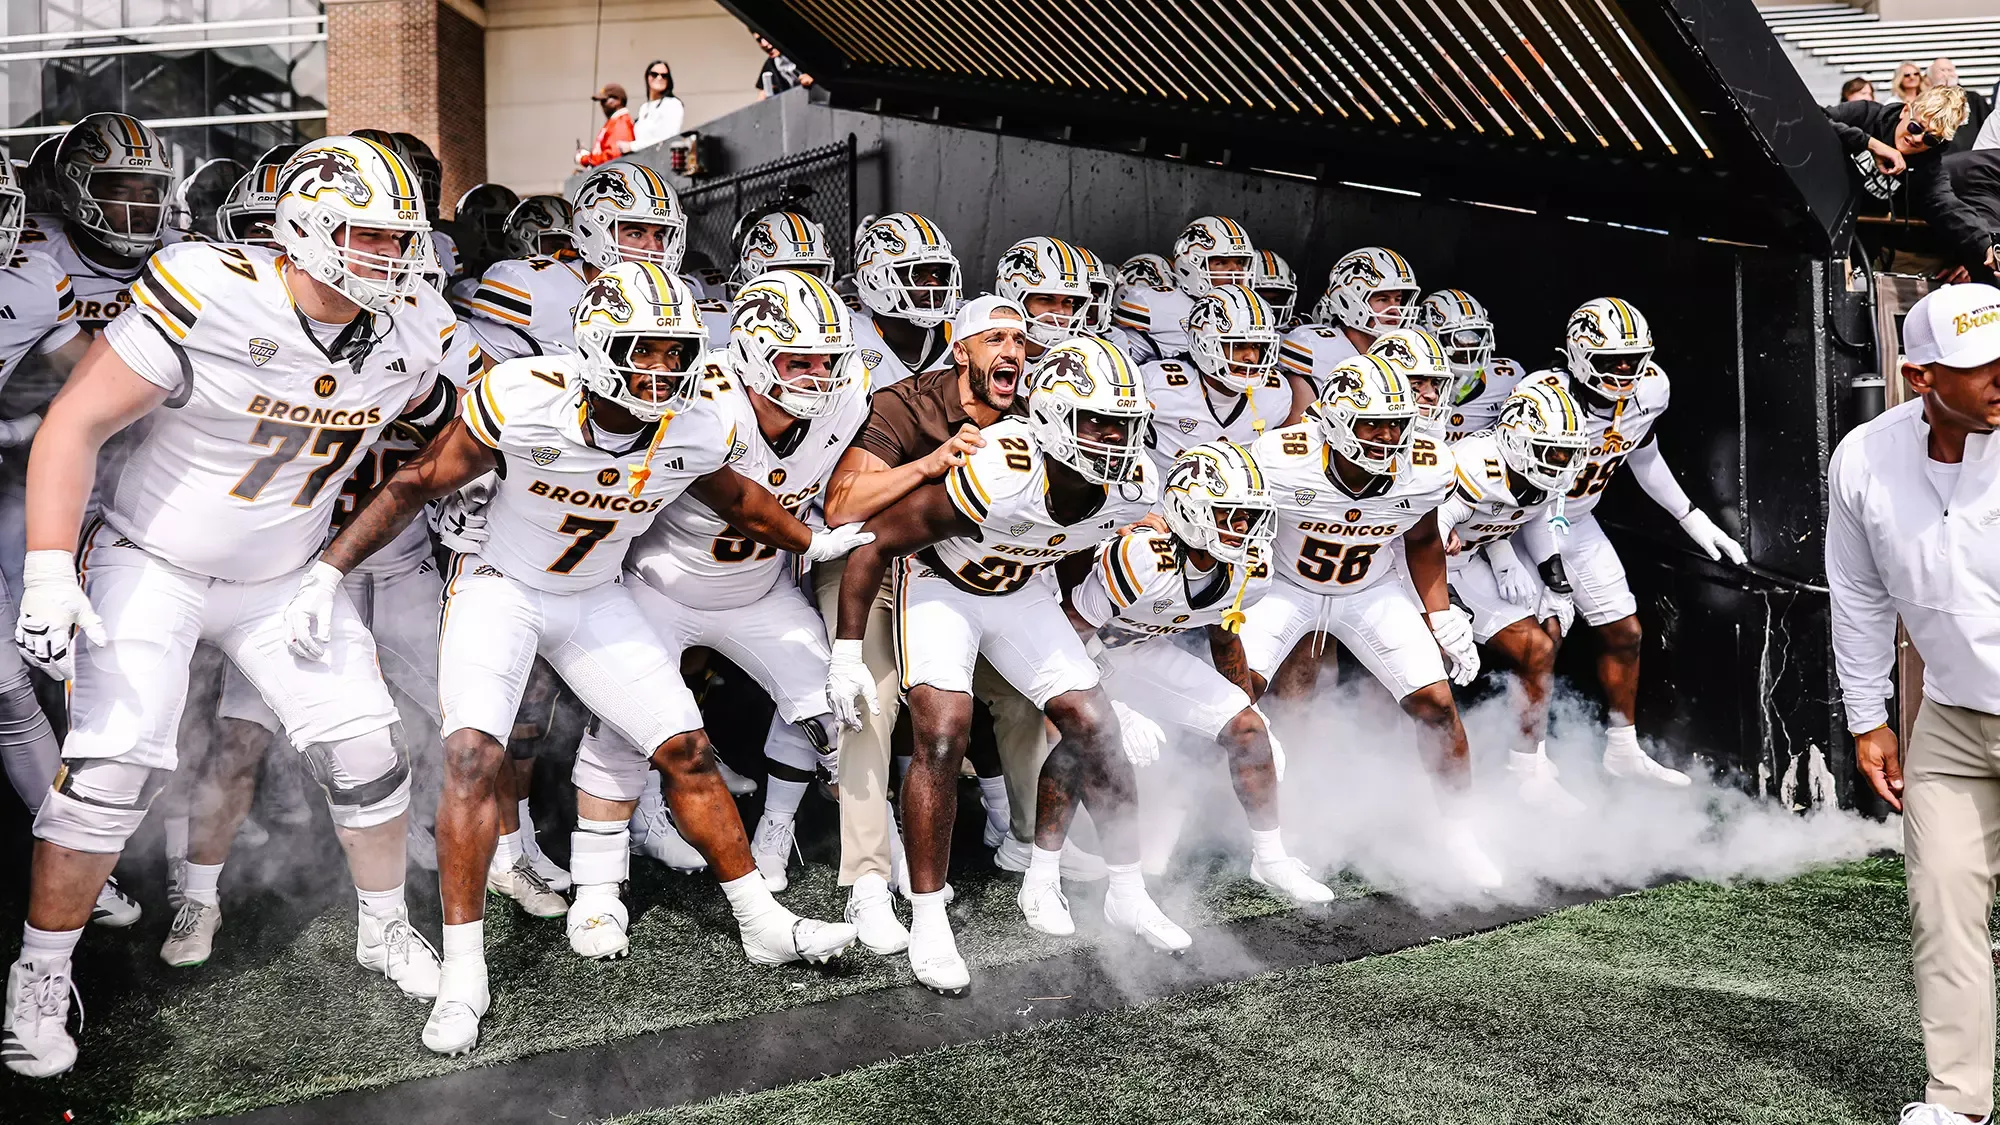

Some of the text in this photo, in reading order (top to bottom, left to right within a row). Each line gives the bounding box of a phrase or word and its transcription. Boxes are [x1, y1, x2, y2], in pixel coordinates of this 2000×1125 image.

[129, 158, 152, 167] GRIT
[397, 210, 420, 221] GRIT
[652, 207, 672, 218] GRIT
[206, 243, 258, 282] 77
[1063, 281, 1079, 289] GRIT
[656, 316, 682, 328] GRIT
[824, 335, 842, 344] GRIT
[530, 369, 566, 390] 7
[1159, 362, 1189, 387] 89
[247, 395, 381, 425] BRONCOS
[1116, 398, 1137, 408] GRIT
[1387, 403, 1406, 412] GRIT
[1281, 431, 1309, 456] 58
[1411, 437, 1438, 467] 58
[229, 418, 367, 508] 77
[998, 436, 1032, 473] 20
[1484, 458, 1502, 479] 11
[527, 479, 664, 514] BRONCOS
[1297, 520, 1398, 537] BRONCOS
[545, 512, 620, 575] 7
